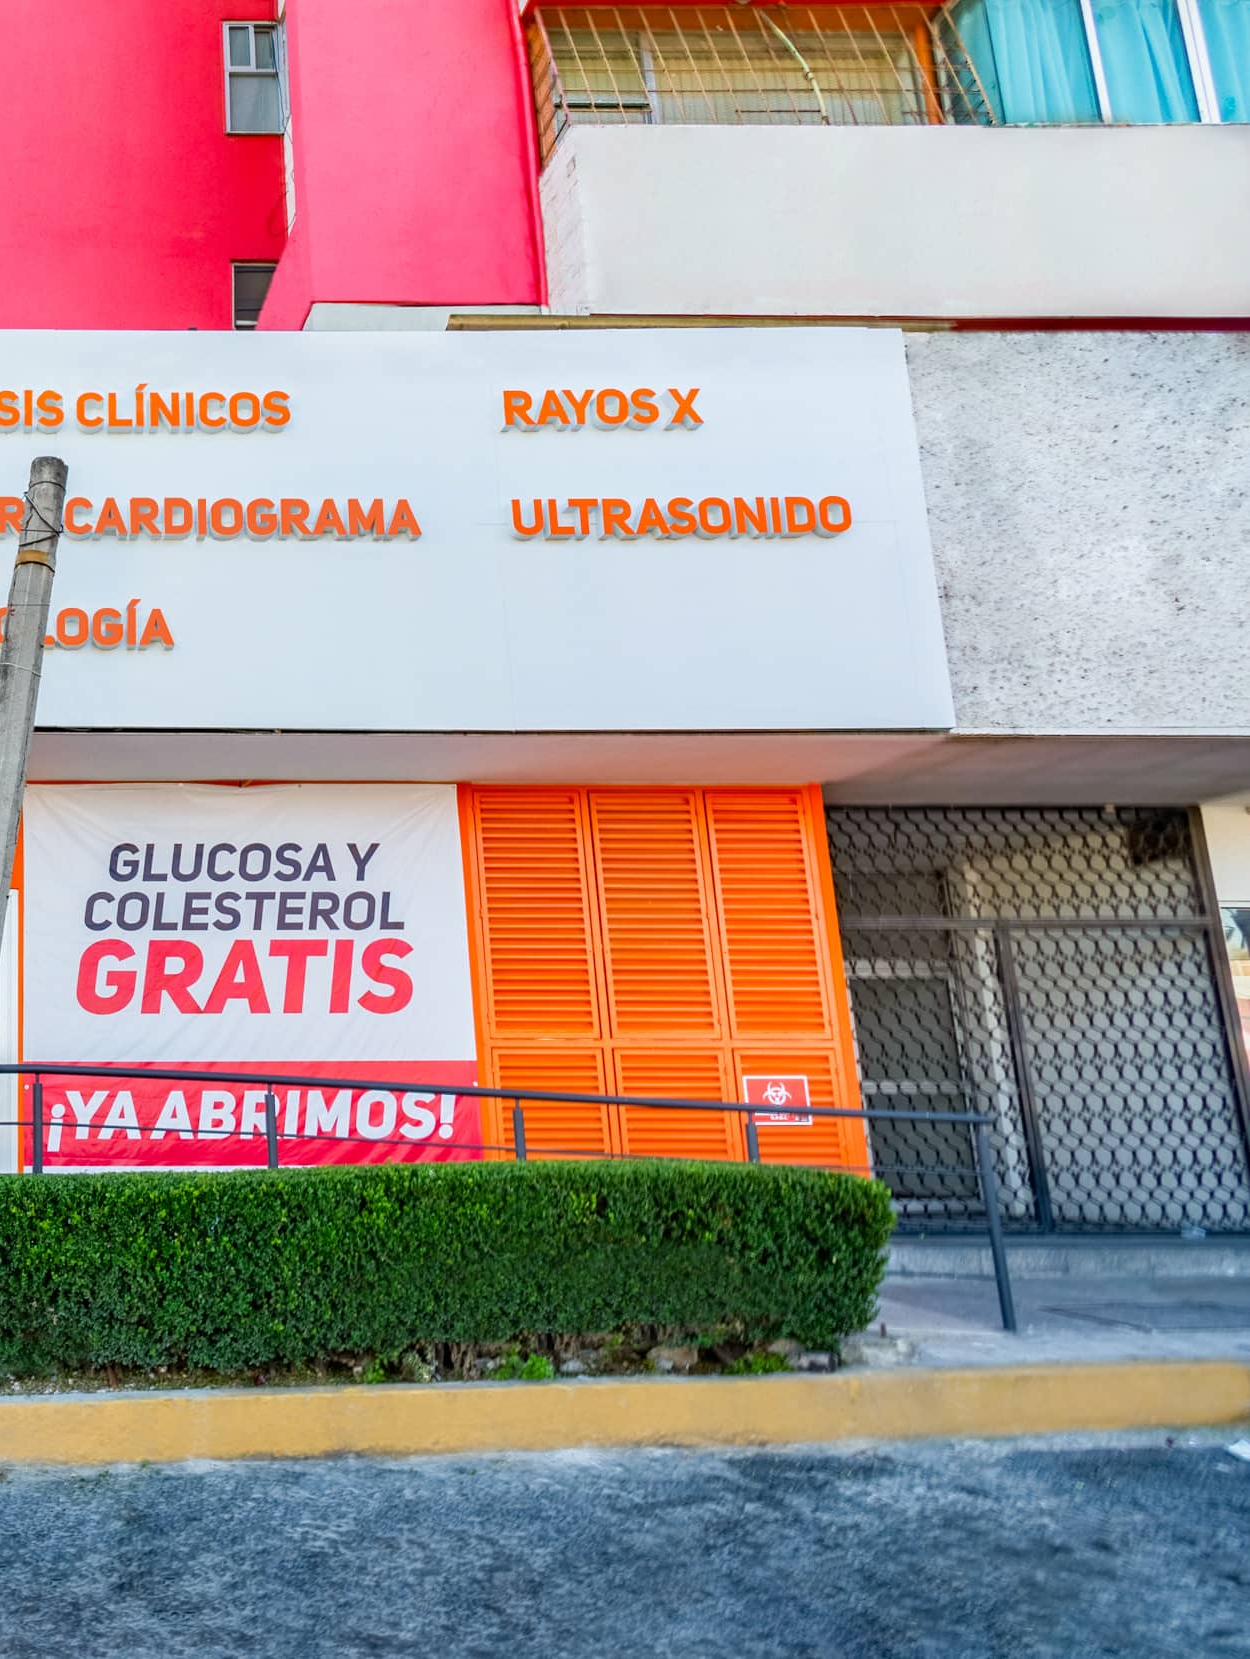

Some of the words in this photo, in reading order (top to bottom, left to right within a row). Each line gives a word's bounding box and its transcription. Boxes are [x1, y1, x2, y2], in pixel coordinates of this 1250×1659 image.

[76, 383, 291, 427] CLÍNICOS
[502, 388, 660, 425] RAYOS
[668, 388, 704, 424] X
[511, 496, 852, 536] ULTRASONIDO
[109, 843, 336, 882] GLUCOSA
[347, 843, 380, 881] Y
[84, 891, 405, 931] COLESTEROL
[76, 938, 414, 1014] GRATIS
[47, 1090, 141, 1152] ¡YA
[151, 1090, 455, 1139] ABRIMOS!
